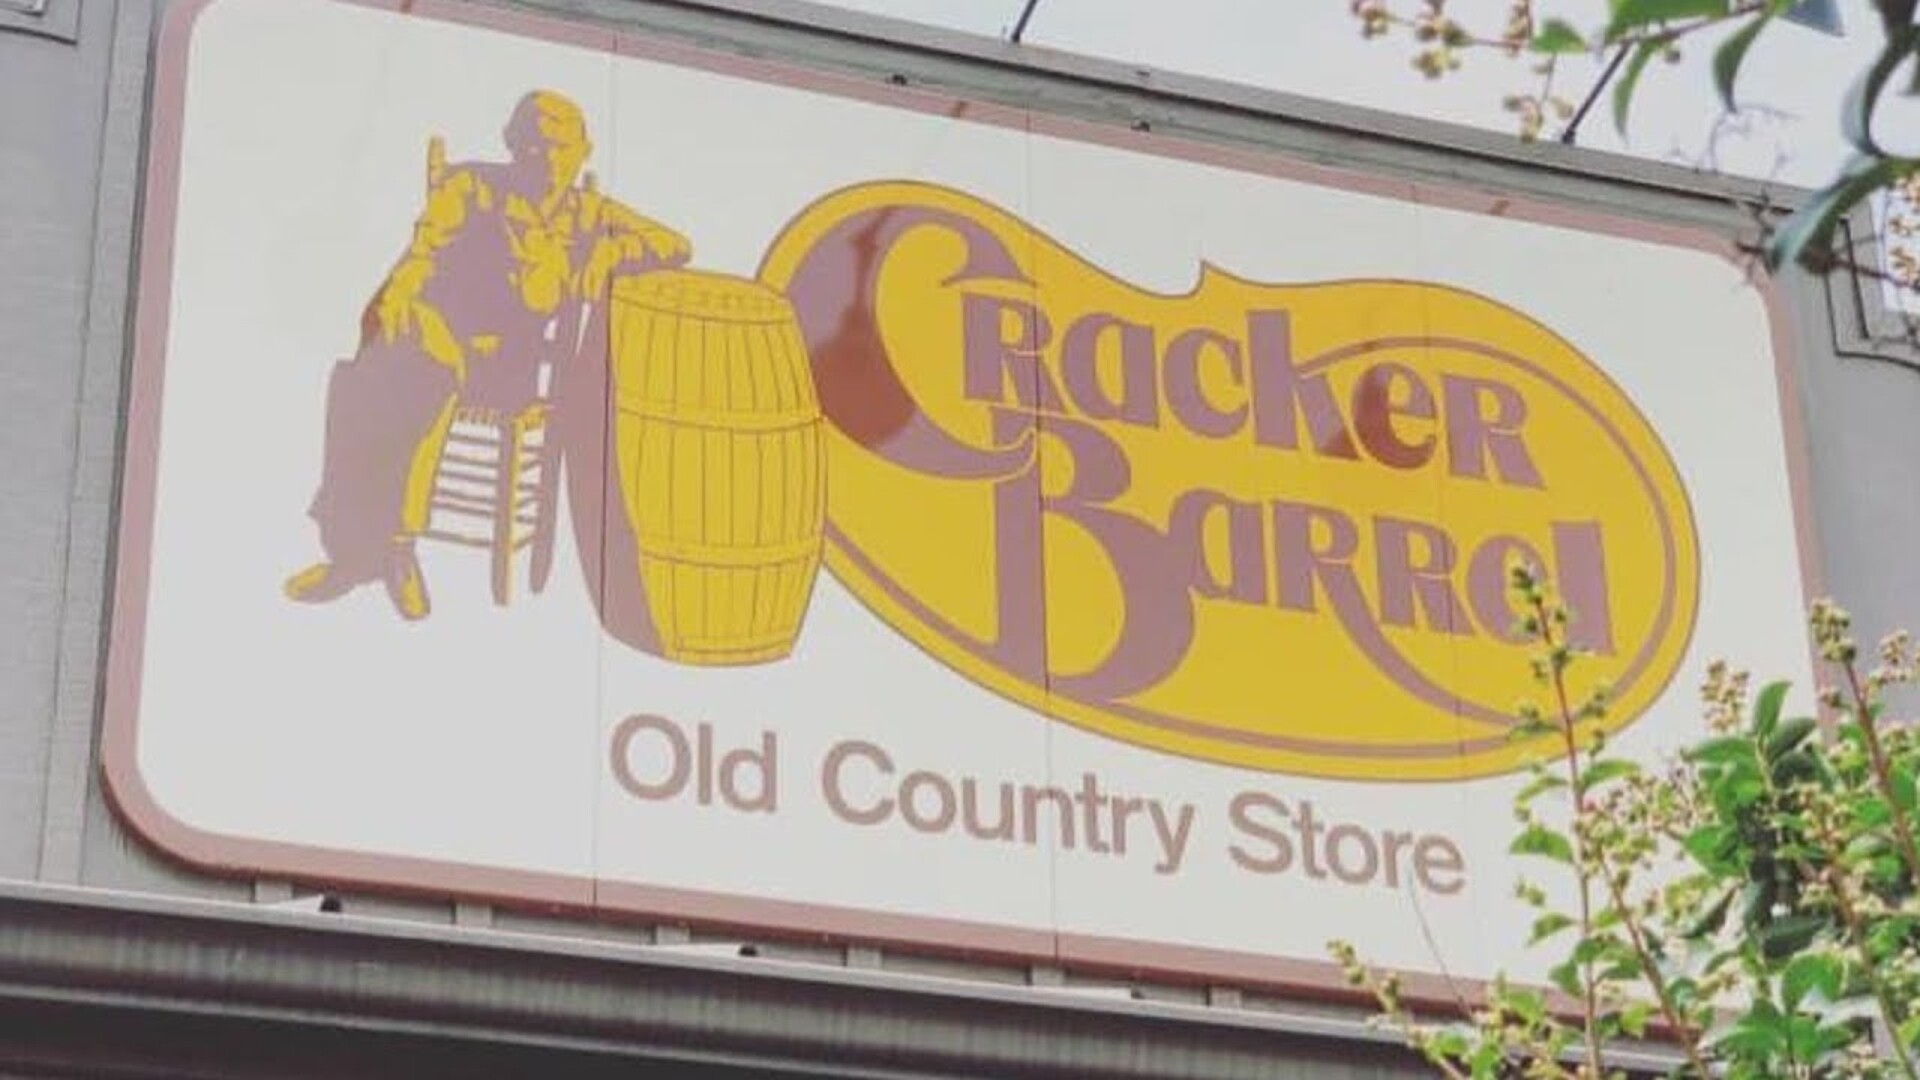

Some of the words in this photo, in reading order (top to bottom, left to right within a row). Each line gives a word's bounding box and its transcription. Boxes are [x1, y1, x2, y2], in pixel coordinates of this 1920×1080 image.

[608, 712, 778, 814] Old
[820, 740, 1194, 876] Country
[1226, 790, 1466, 896] Store
